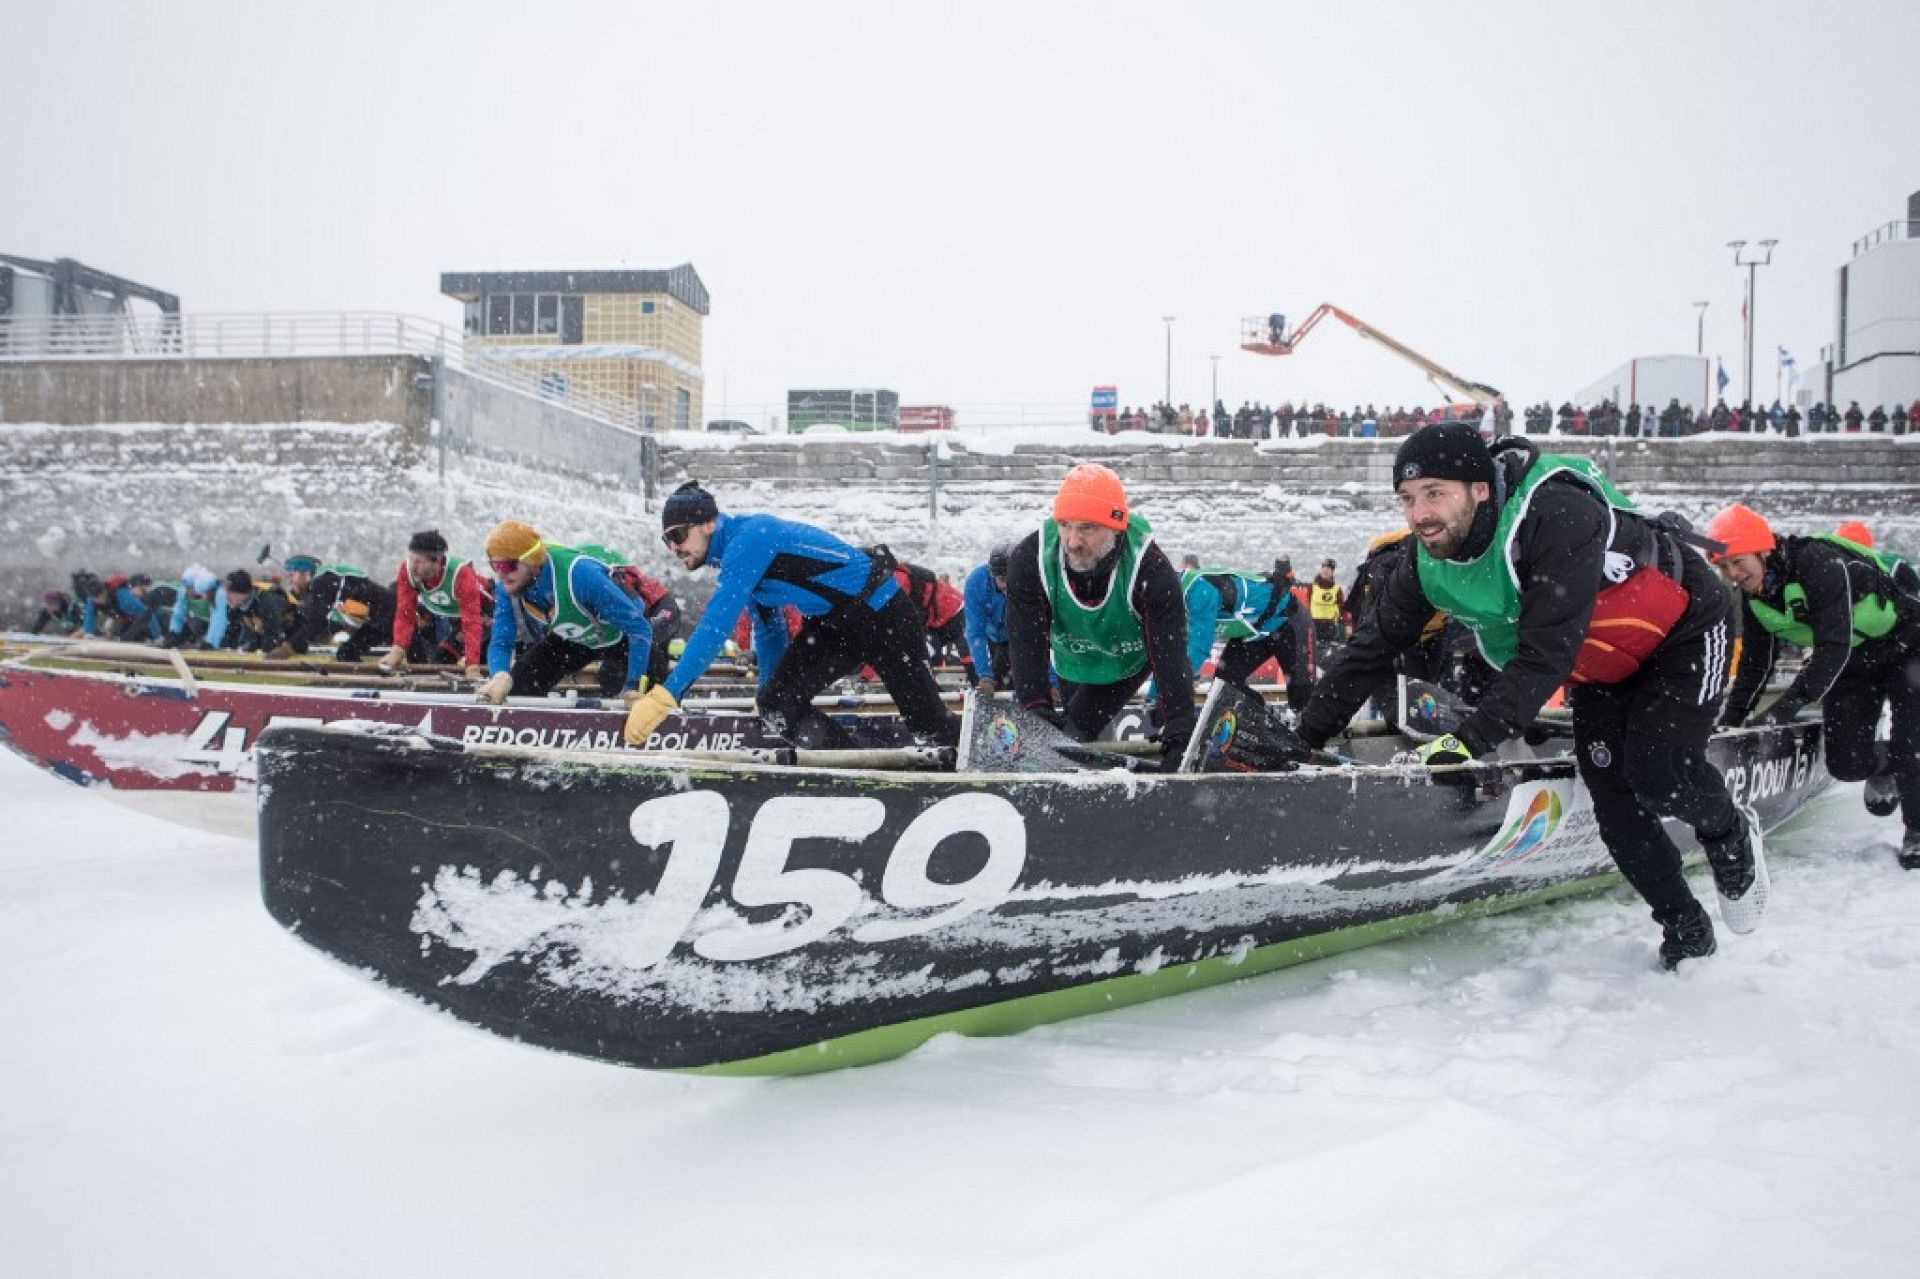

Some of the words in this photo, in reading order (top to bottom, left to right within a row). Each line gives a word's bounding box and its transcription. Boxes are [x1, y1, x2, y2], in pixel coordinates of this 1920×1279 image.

[463, 724, 637, 751] REDOUTABL
[643, 732, 746, 751] POLAIRE
[1746, 756, 1793, 808] pour
[629, 789, 1028, 970] 159
